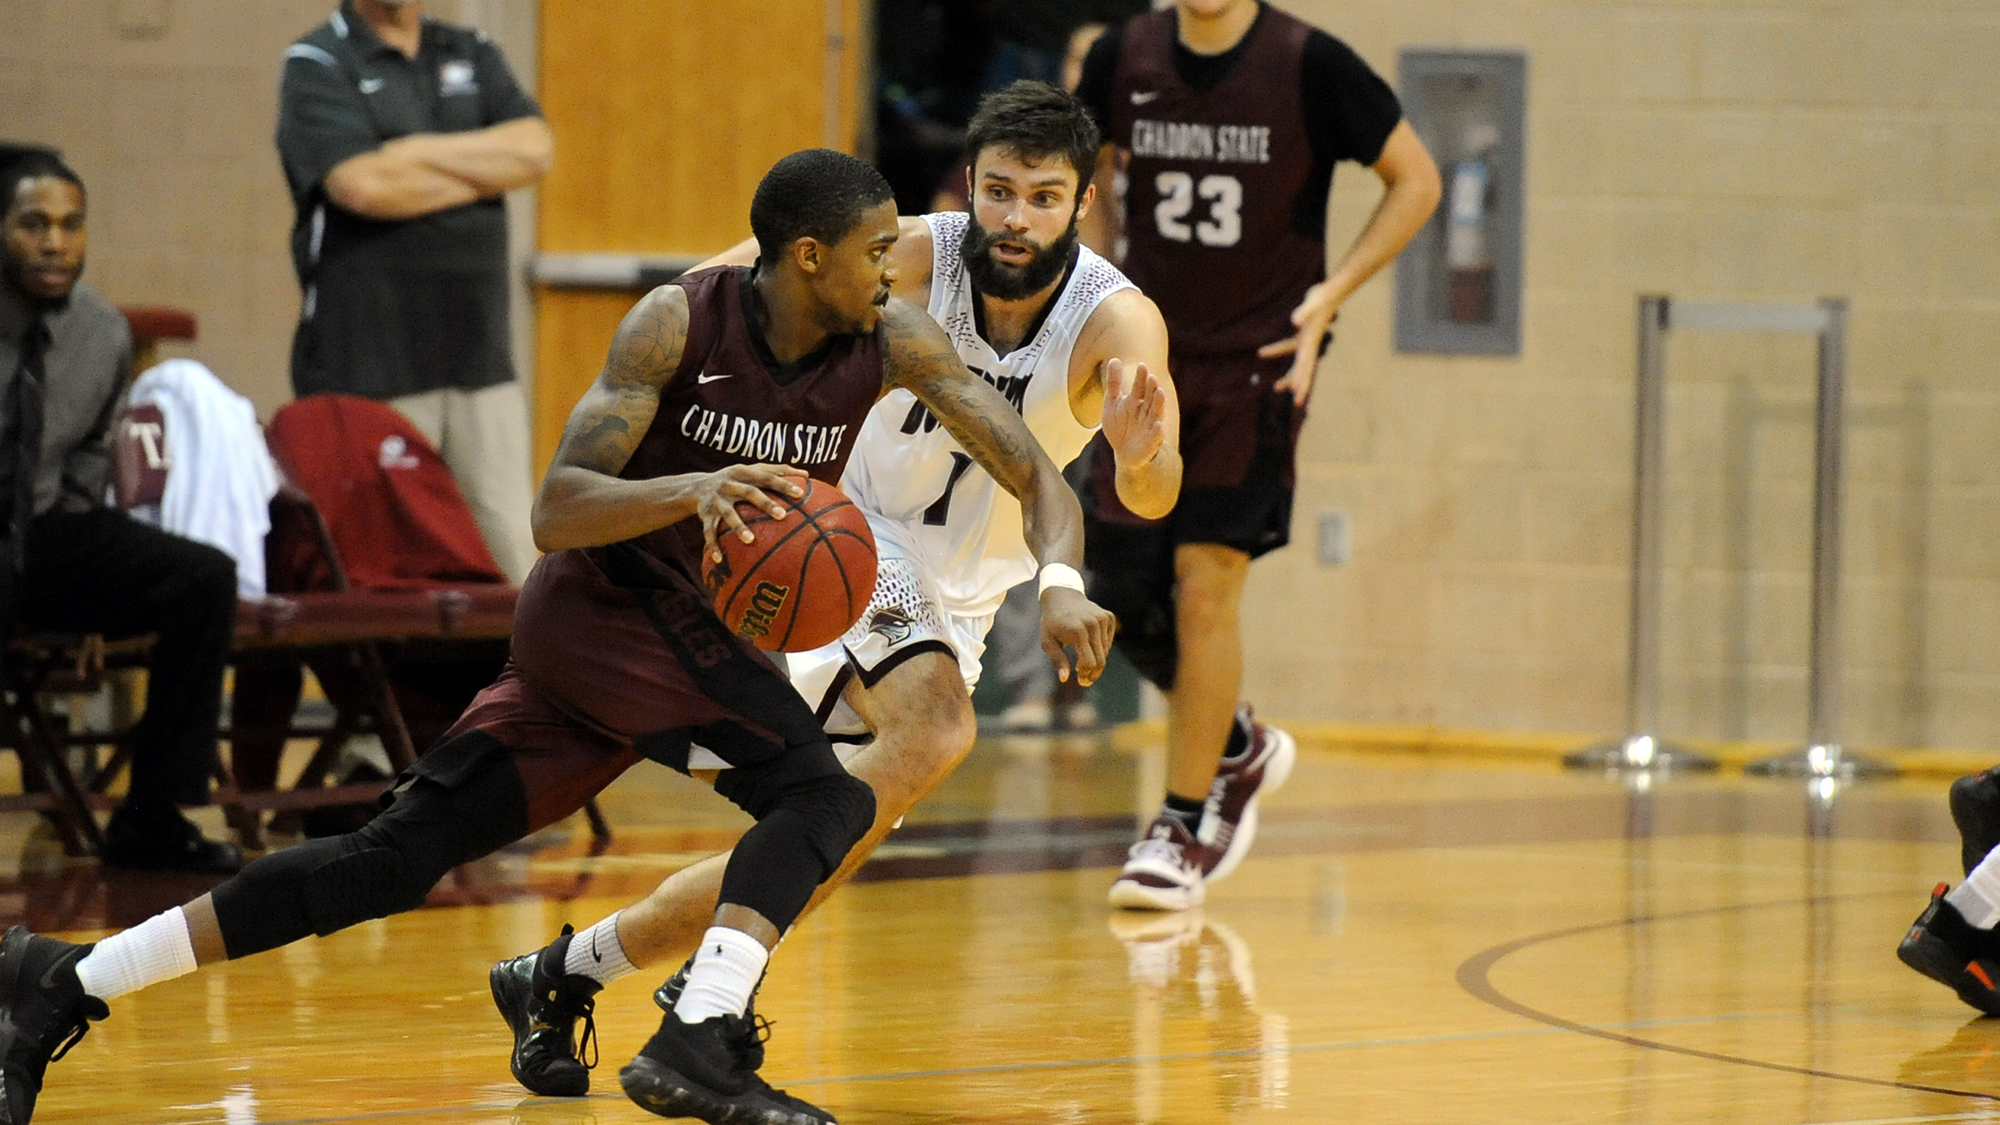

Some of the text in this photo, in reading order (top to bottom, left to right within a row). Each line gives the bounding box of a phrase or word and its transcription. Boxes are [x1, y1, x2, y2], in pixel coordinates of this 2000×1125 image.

[1217, 125, 1270, 163] STATE
[1155, 170, 1243, 247] 23
[681, 403, 847, 465] CHADRON STATE
